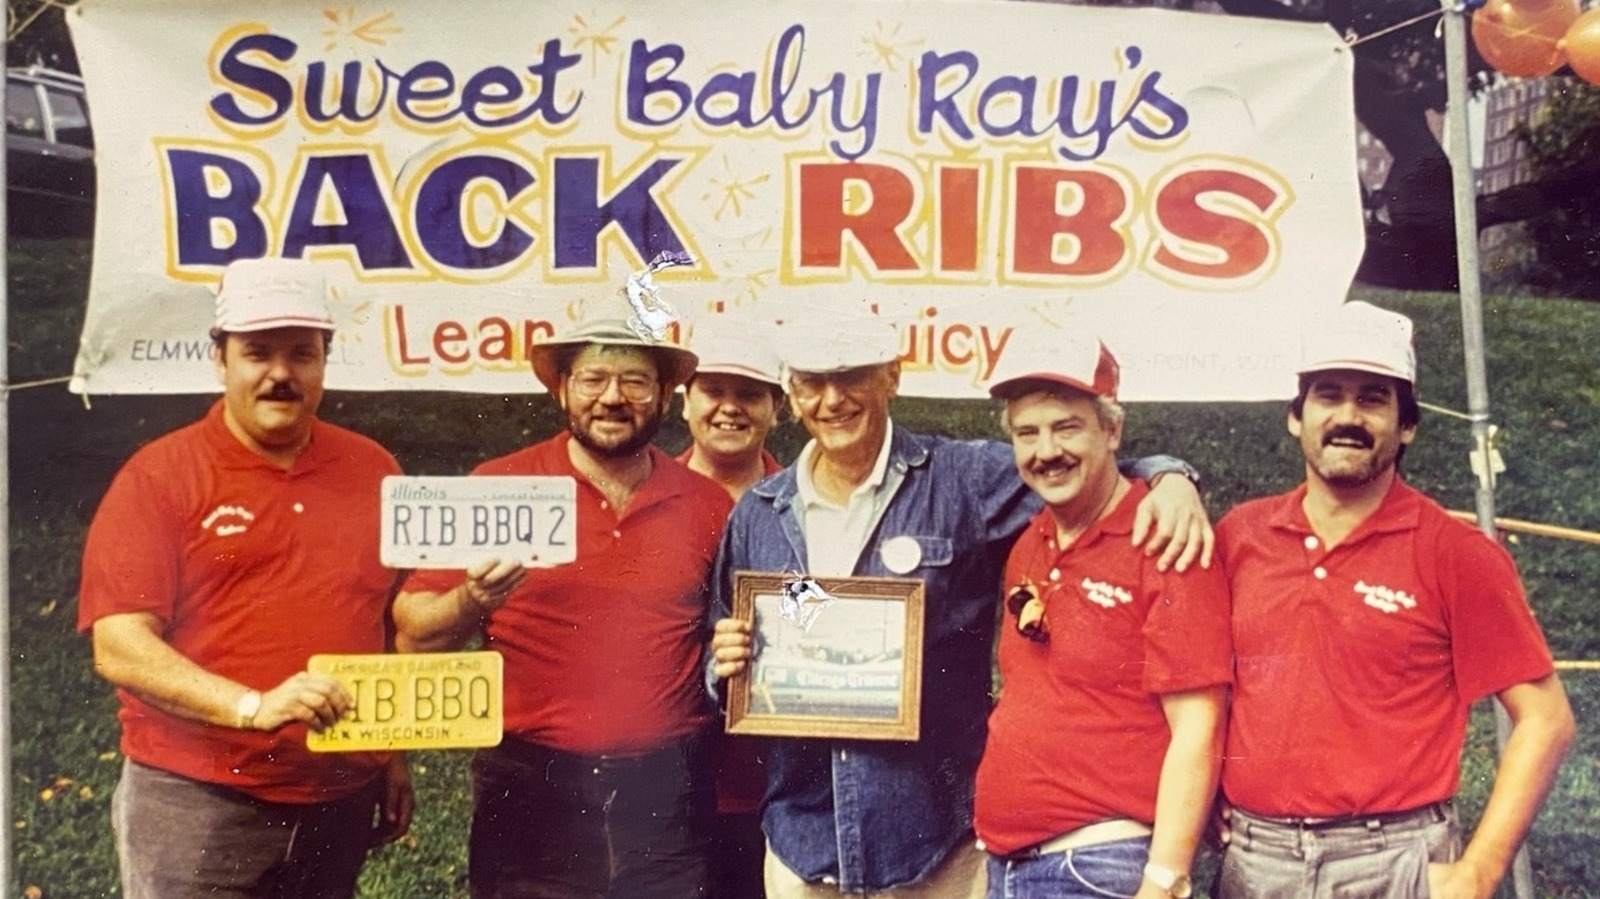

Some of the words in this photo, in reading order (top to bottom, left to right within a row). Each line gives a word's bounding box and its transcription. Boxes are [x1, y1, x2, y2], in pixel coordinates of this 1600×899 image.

[209, 33, 584, 127] Sweet
[626, 24, 882, 161] Baby
[917, 45, 1189, 161] Ray's
[166, 149, 700, 269] BACK
[799, 161, 1279, 278] RIBS
[871, 303, 1014, 381] uicy
[391, 483, 447, 500] Illinois
[392, 504, 457, 547] RIB
[471, 504, 534, 546] BBQ
[547, 505, 567, 546] 2
[347, 677, 397, 723] IB
[414, 676, 491, 721] BBQ
[360, 726, 452, 741] WISCONSIN
